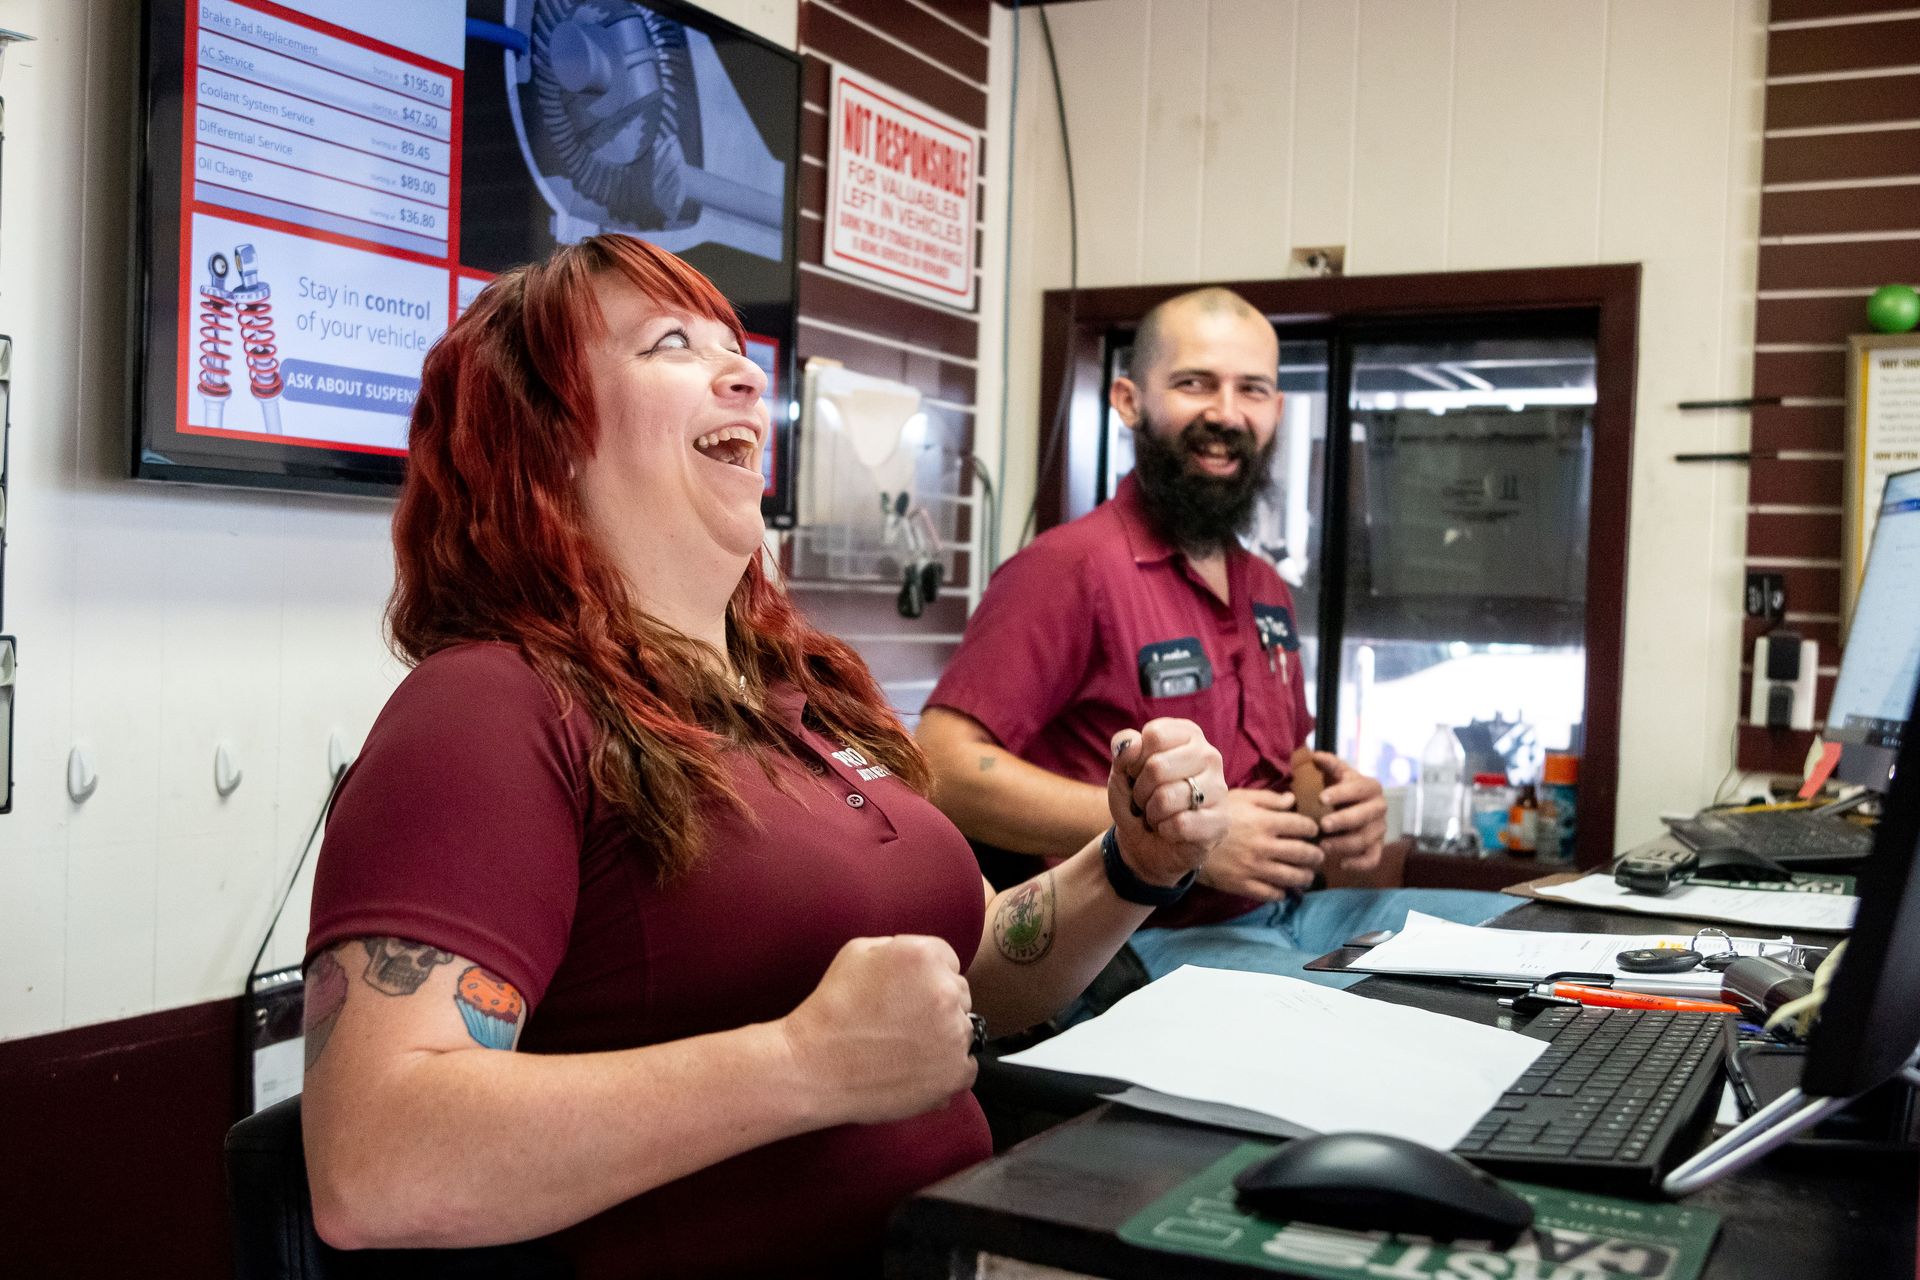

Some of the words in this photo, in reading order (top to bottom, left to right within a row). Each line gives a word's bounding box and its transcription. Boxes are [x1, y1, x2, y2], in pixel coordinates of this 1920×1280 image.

[202, 6, 231, 26] Brake
[235, 18, 253, 34] Pad
[257, 25, 318, 56] Replacement
[200, 45, 215, 60] AC
[218, 50, 254, 72] Service
[403, 73, 445, 98] $195.00
[200, 82, 239, 105] Coolant
[242, 95, 278, 115] System
[282, 106, 315, 126] Service
[402, 107, 437, 129] $47.50
[199, 119, 255, 144] Differential
[258, 136, 293, 155] Service
[401, 140, 431, 160] 89.45
[844, 98, 872, 160] NOT
[875, 114, 966, 197] RESPONSIBLE
[199, 157, 212, 169] Oil
[215, 161, 253, 182] Change
[401, 174, 436, 196] $89.00
[848, 160, 877, 190] FOR
[881, 173, 960, 221] VALUABLES
[400, 208, 435, 228] $36.80
[843, 184, 876, 214] LEFT
[899, 206, 962, 246] VEHICLES
[299, 276, 338, 308] Stay
[344, 284, 359, 307] in
[365, 294, 431, 320] control
[297, 310, 317, 332] of
[320, 318, 362, 340] your
[287, 372, 314, 390] ASK
[316, 376, 363, 397] ABOUT
